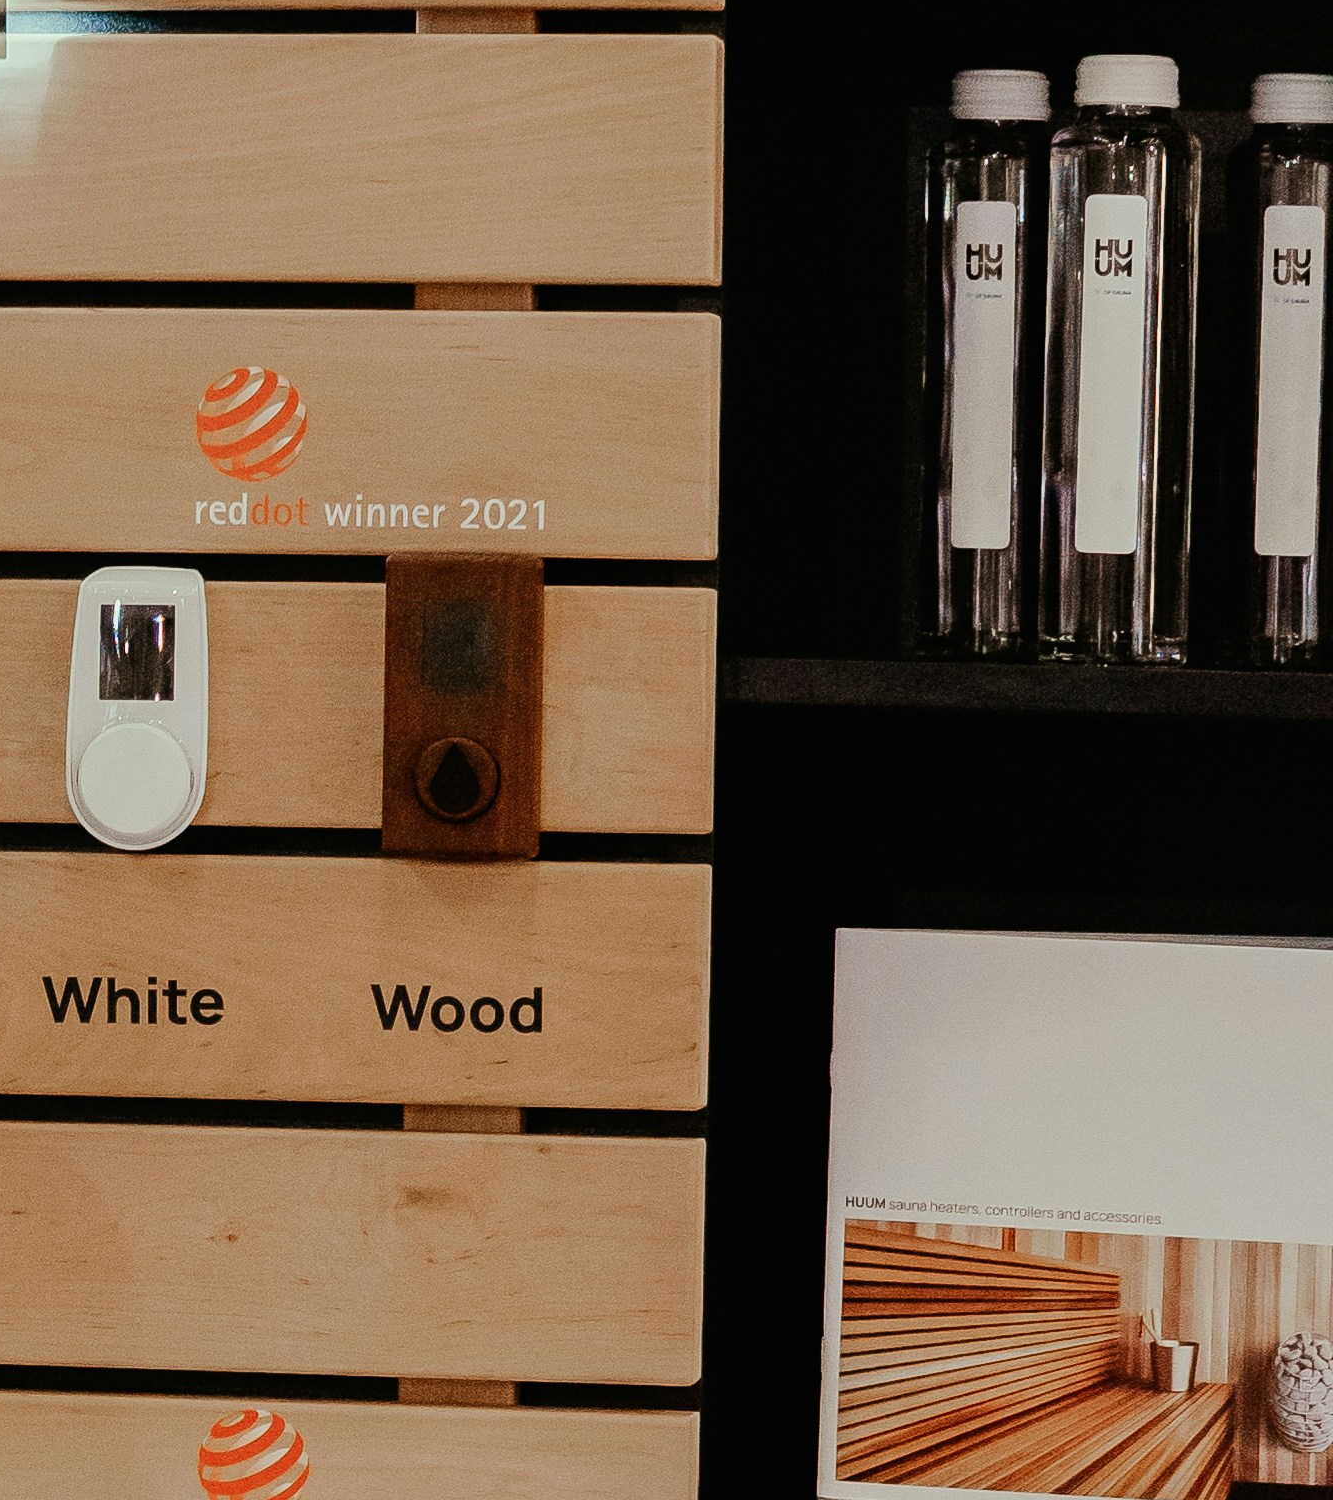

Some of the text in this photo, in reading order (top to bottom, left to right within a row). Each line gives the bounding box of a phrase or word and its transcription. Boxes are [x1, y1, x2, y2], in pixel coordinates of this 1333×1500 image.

[966, 244, 1003, 263] HU
[1095, 238, 1133, 259] HU
[1274, 248, 1311, 268] HU
[966, 261, 1003, 280] UM
[1095, 257, 1132, 277] UM
[1273, 266, 1310, 286] UM
[194, 492, 546, 531] reddot winner 2021
[42, 977, 223, 1025] White
[371, 985, 543, 1033] Wood
[845, 1196, 885, 1209] HUUM
[889, 1200, 927, 1212] sauna
[985, 1205, 1054, 1220] controllers
[1057, 1209, 1081, 1221] and
